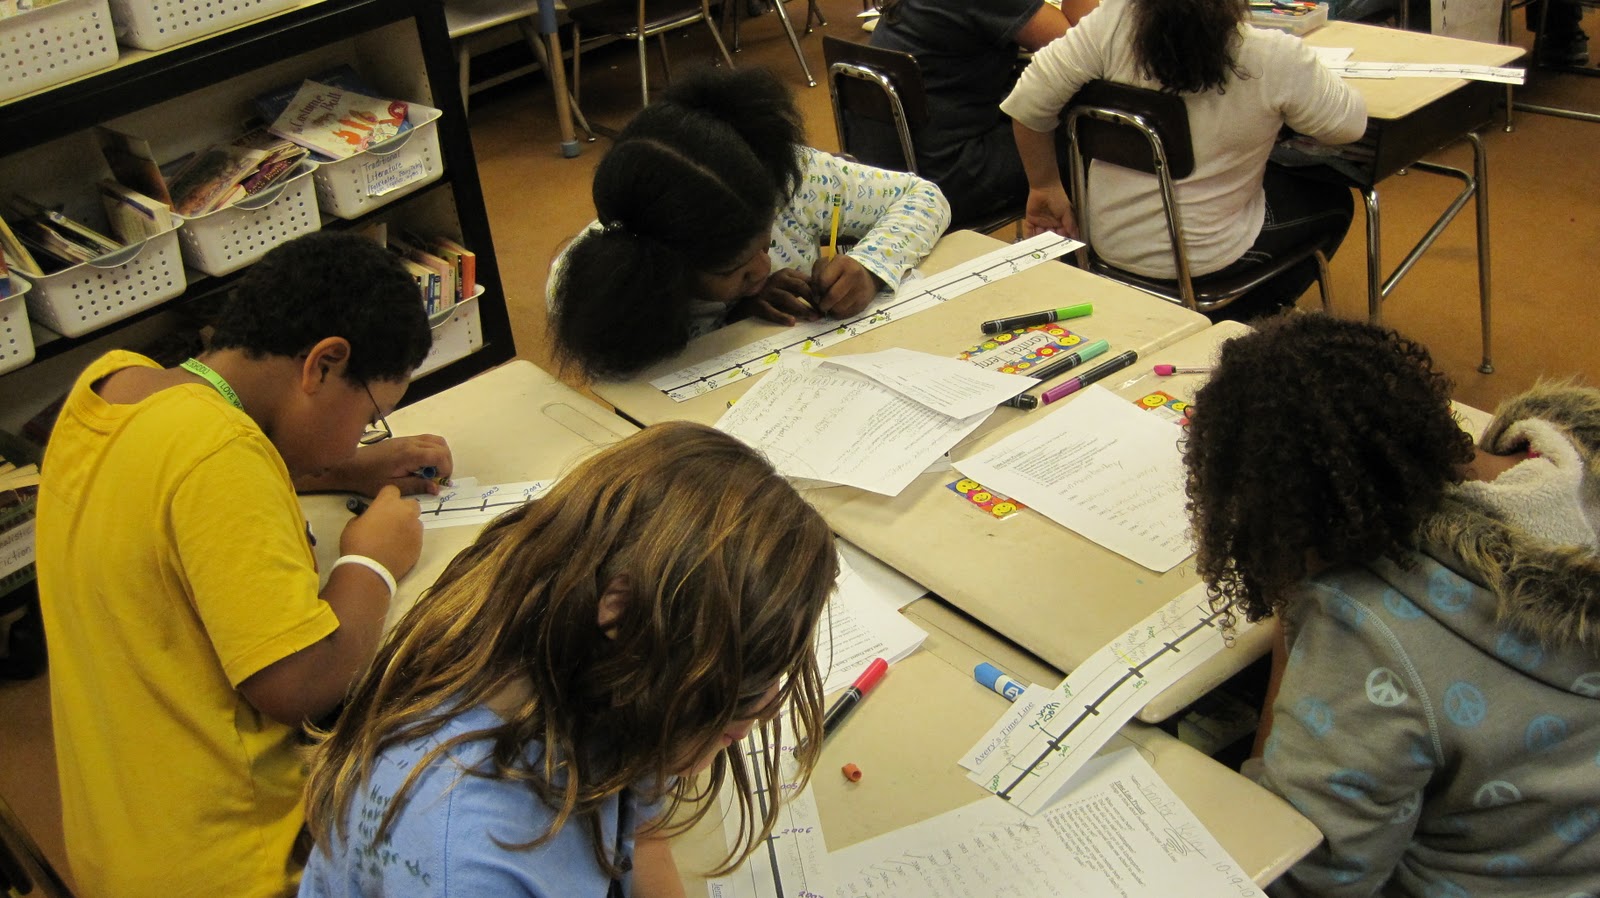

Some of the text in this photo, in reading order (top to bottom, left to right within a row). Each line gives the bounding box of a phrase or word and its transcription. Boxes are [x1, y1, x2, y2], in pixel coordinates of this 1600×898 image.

[320, 91, 342, 111] Ball
[363, 153, 401, 171] Traditional
[366, 162, 403, 183] Literature
[220, 382, 236, 400] LOVE
[481, 486, 500, 500] 2003
[523, 481, 542, 497] 2004
[0, 526, 33, 548] ealistic
[973, 738, 1002, 765] Avery's
[1000, 717, 1020, 737] Time
[1017, 701, 1034, 719] Line
[781, 827, 814, 835] 2006
